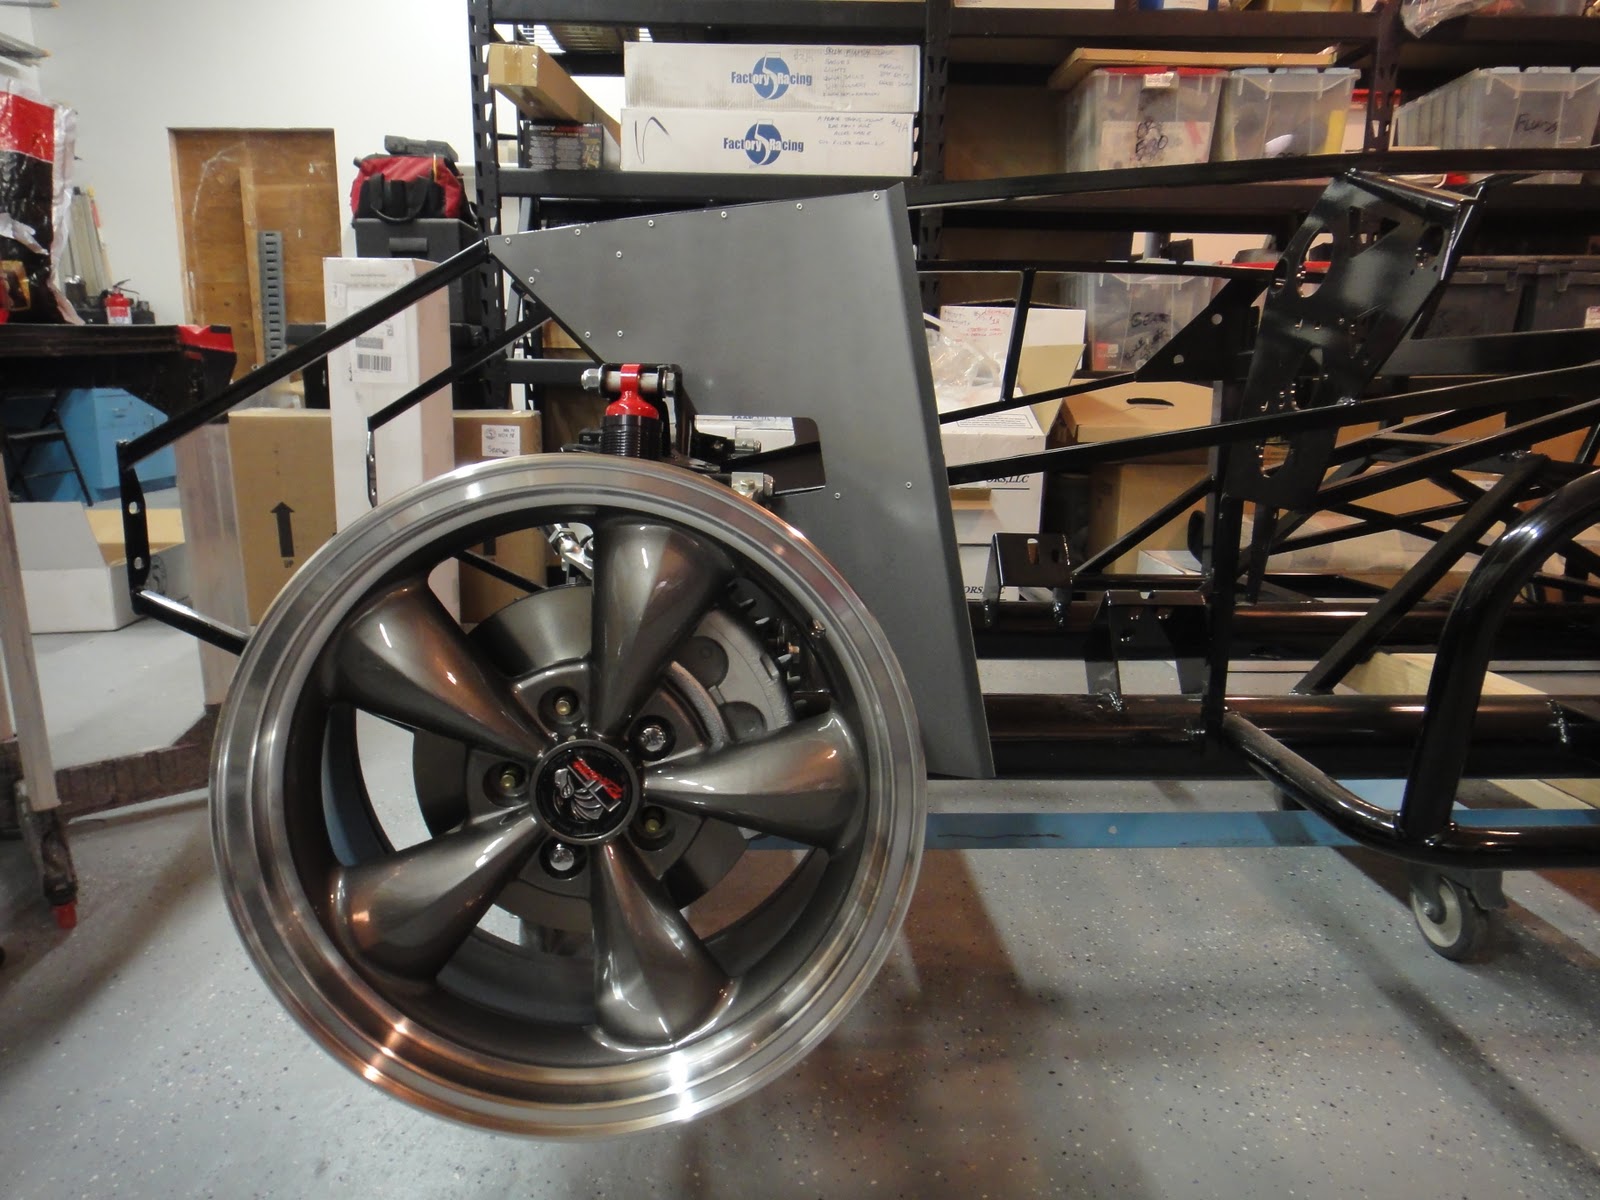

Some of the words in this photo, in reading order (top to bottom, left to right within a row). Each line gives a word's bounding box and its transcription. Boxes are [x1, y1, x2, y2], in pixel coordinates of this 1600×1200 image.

[731, 71, 770, 86] Factory
[776, 72, 812, 86] Racing
[723, 137, 762, 152] Factory
[769, 138, 804, 152] Racing
